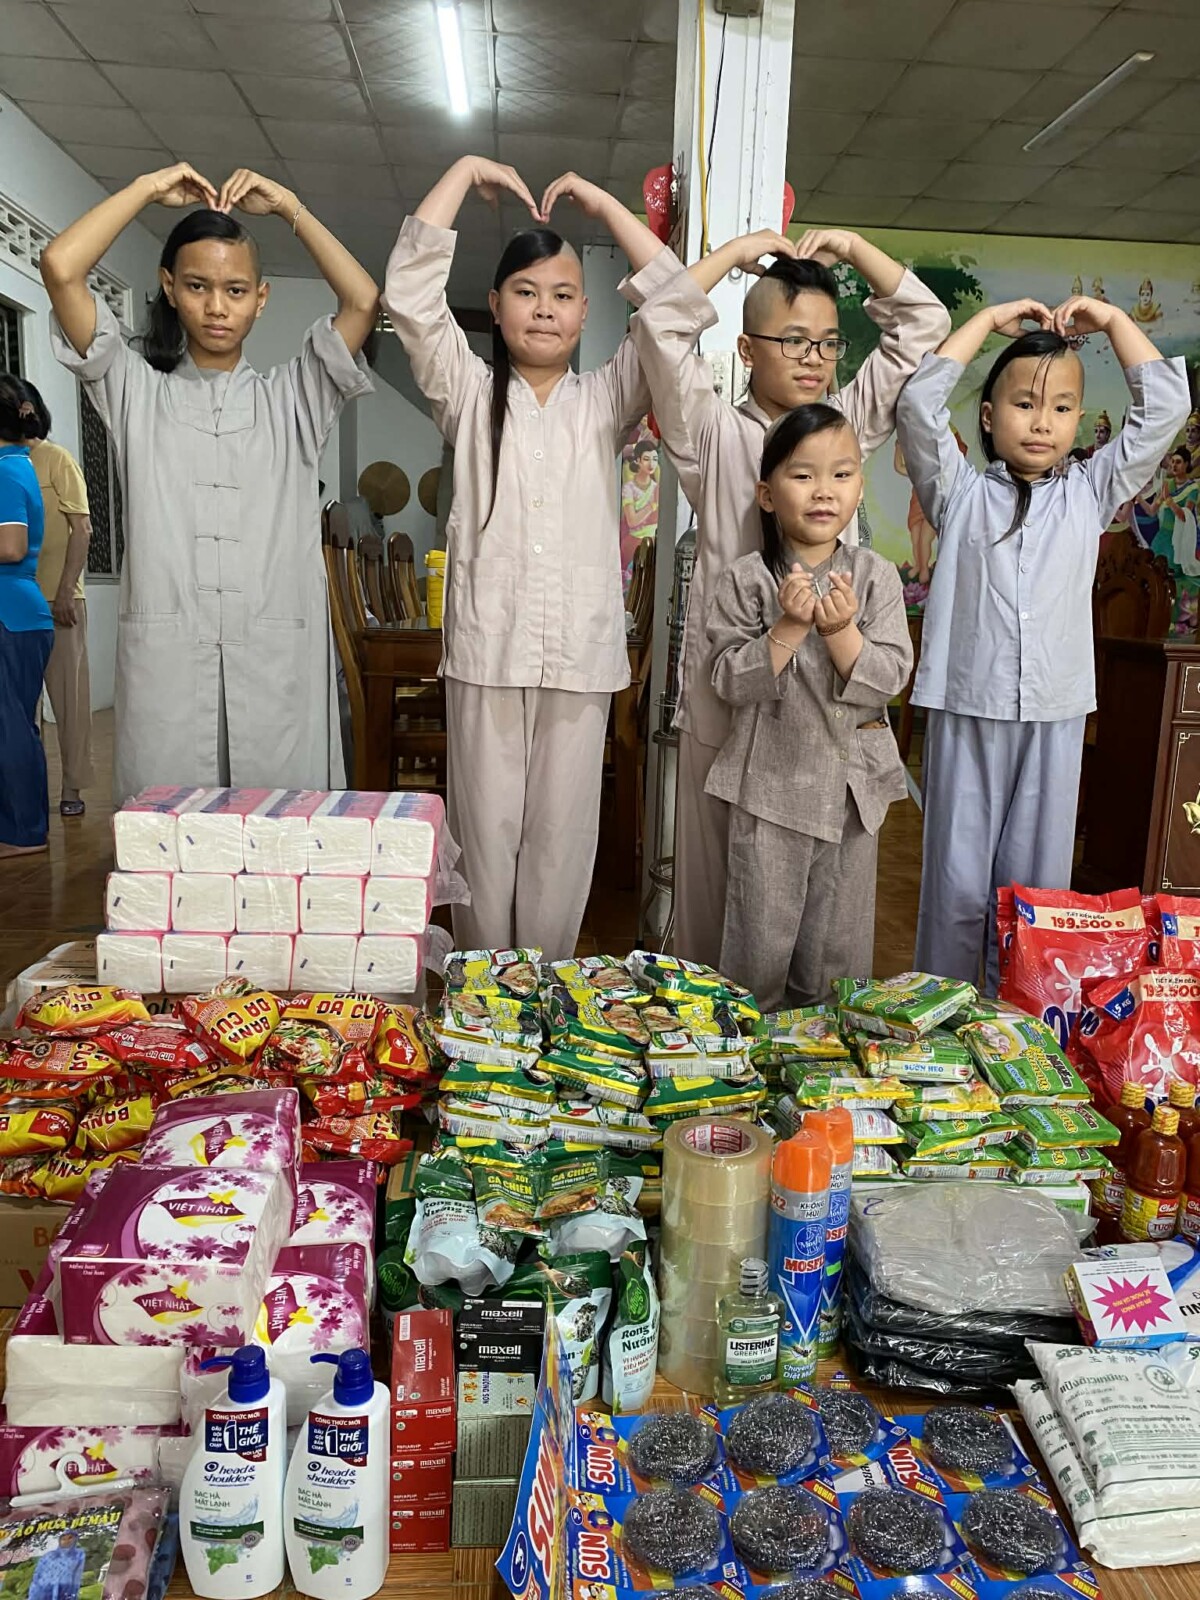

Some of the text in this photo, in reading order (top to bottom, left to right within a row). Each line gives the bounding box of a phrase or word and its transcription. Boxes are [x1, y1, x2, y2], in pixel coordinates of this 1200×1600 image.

[1051, 916, 1112, 930] 199.500
[159, 1052, 175, 1061] CUA
[168, 1202, 235, 1216] VIỆT NHẬT
[142, 1299, 191, 1312] VIỆT NHẬT
[269, 1287, 289, 1332] VIỆT NHẬT
[621, 1325, 649, 1339] Rong
[478, 1345, 521, 1355] maxell
[730, 1338, 775, 1350] LISTERINE
[414, 1339, 426, 1372] maxell
[426, 1407, 451, 1415] maxell
[239, 1434, 263, 1446] GIỚI
[420, 1458, 445, 1466] maxell
[588, 1446, 614, 1485] SUN
[889, 1448, 924, 1484] SUN
[219, 1465, 249, 1475] head
[321, 1467, 350, 1476] head
[203, 1474, 255, 1482] shoulders
[307, 1474, 356, 1485] shoulders
[813, 1484, 834, 1502] JUMBO
[915, 1482, 938, 1498] JUMBO
[579, 1533, 609, 1578] SUN
[950, 1580, 975, 1600] JUMBO
[1072, 1579, 1098, 1599] JUMBO
